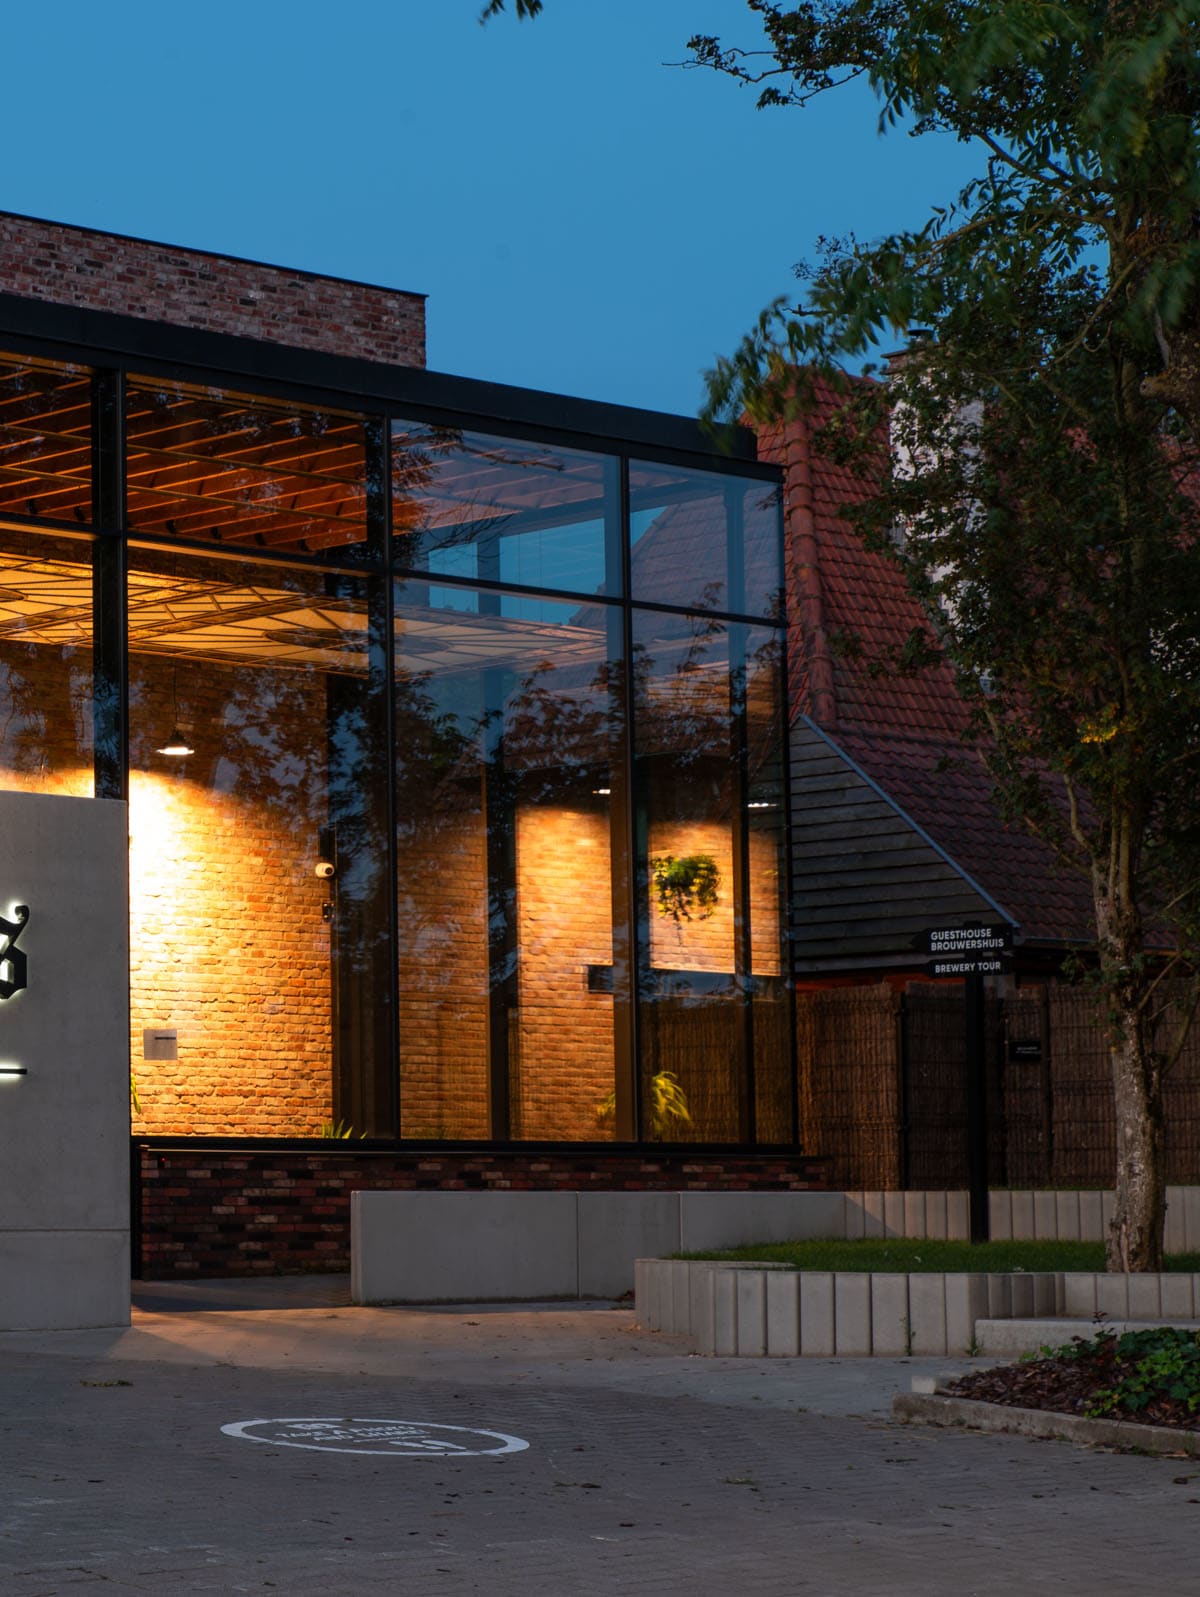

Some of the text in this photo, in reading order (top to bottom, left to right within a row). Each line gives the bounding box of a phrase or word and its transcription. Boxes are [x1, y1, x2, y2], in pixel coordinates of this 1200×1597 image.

[930, 928, 991, 940] GUESTHOUSE
[930, 938, 1004, 951] BROUWERSHUIS
[935, 962, 1001, 973] BREWERY TOUR
